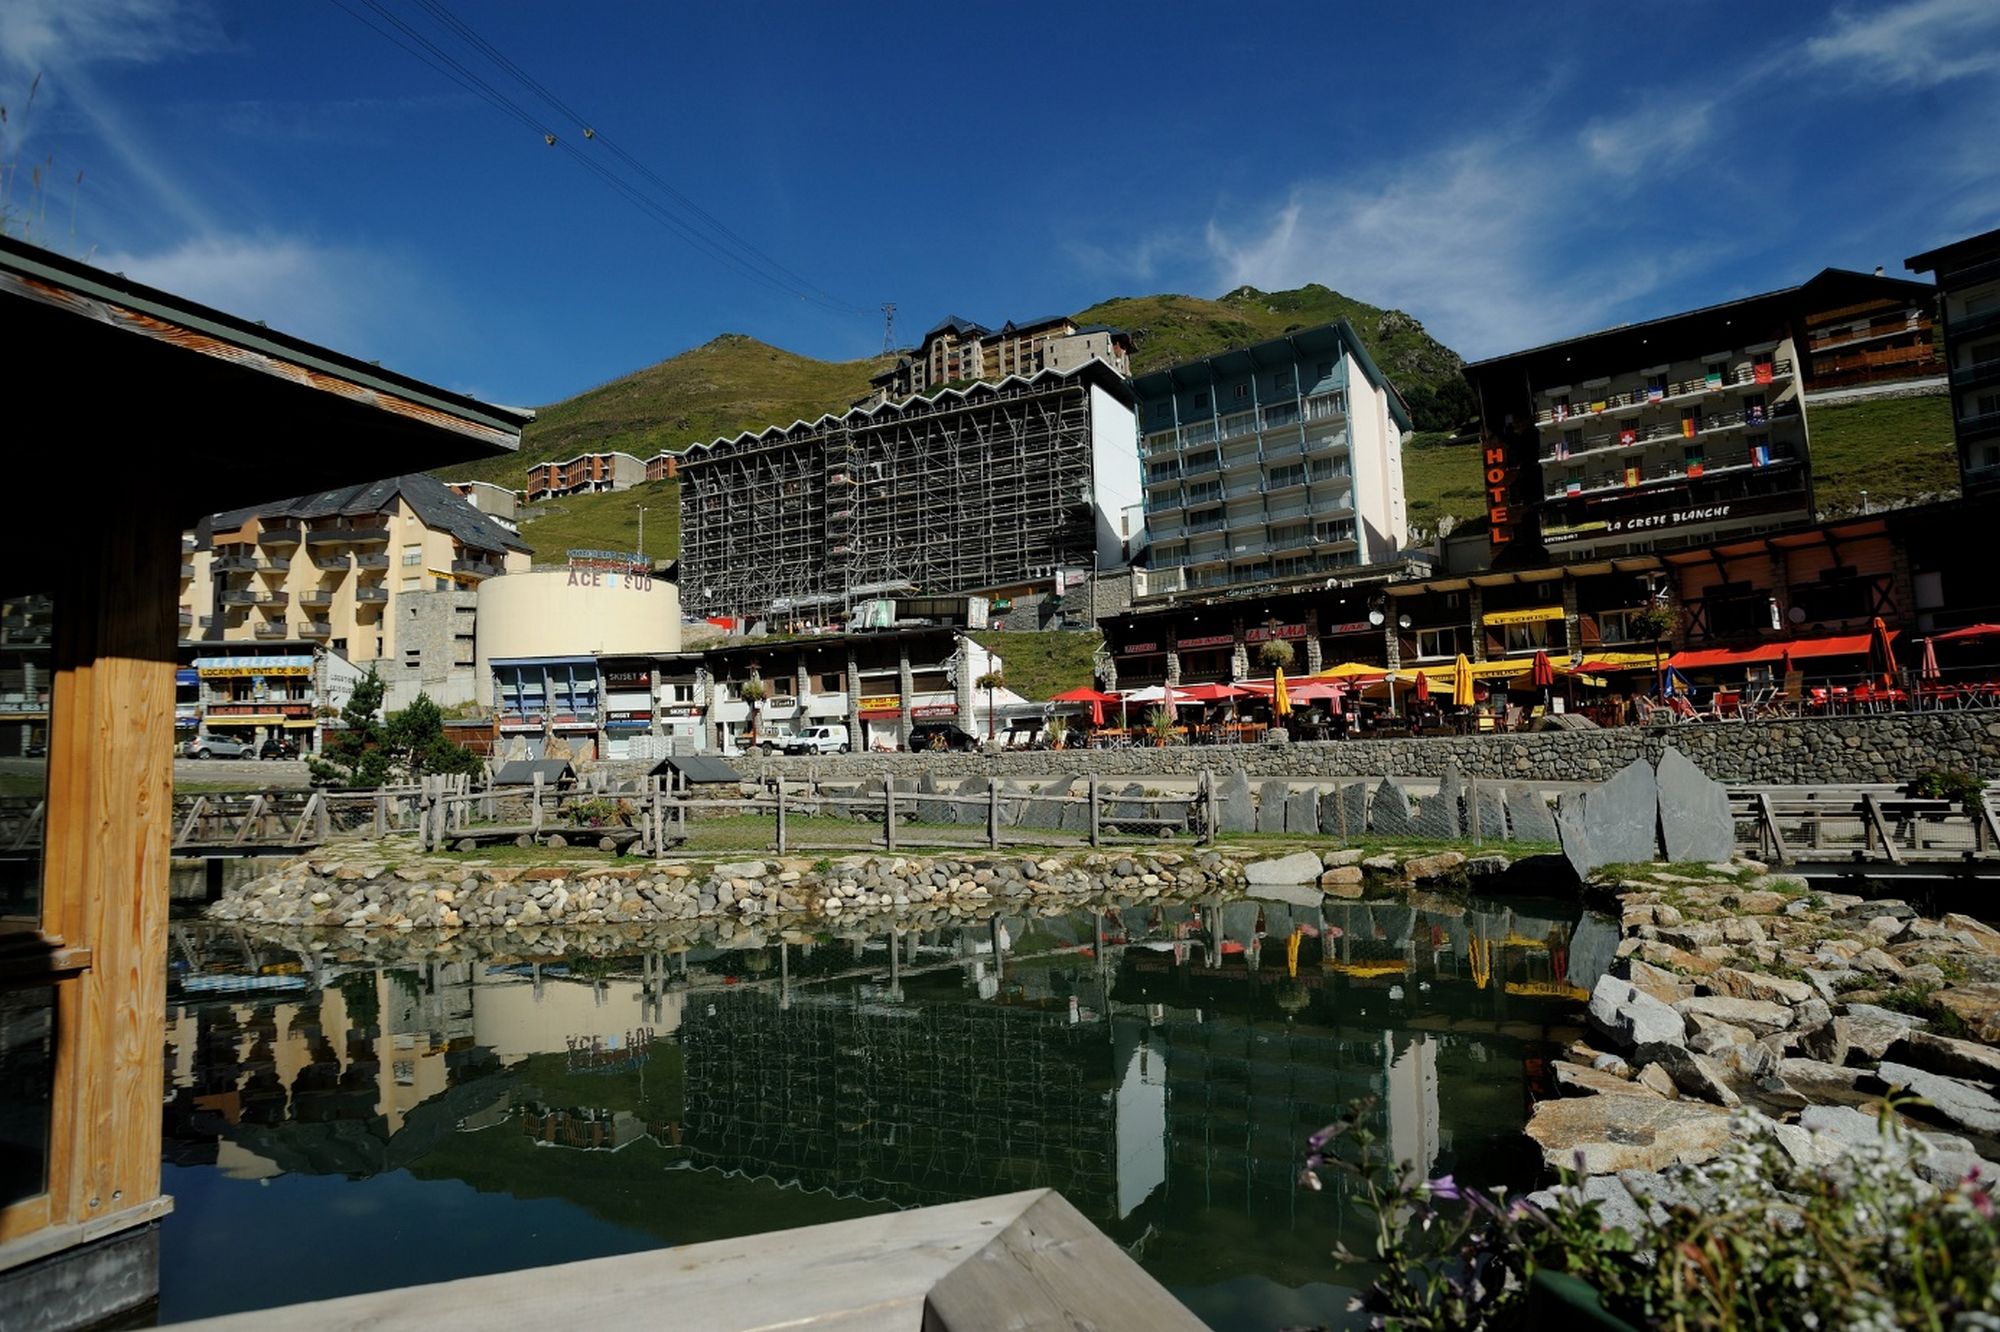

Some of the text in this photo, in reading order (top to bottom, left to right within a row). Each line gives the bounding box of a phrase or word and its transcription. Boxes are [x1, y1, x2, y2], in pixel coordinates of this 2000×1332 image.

[1486, 448, 1510, 543] HOTEL
[1607, 506, 1731, 532] LA CRETE BLANCHE
[624, 574, 652, 593] SUD
[202, 668, 243, 676] LOCATION
[247, 667, 273, 675] VENTE
[277, 667, 288, 675] DE
[609, 673, 637, 681] SKISET
